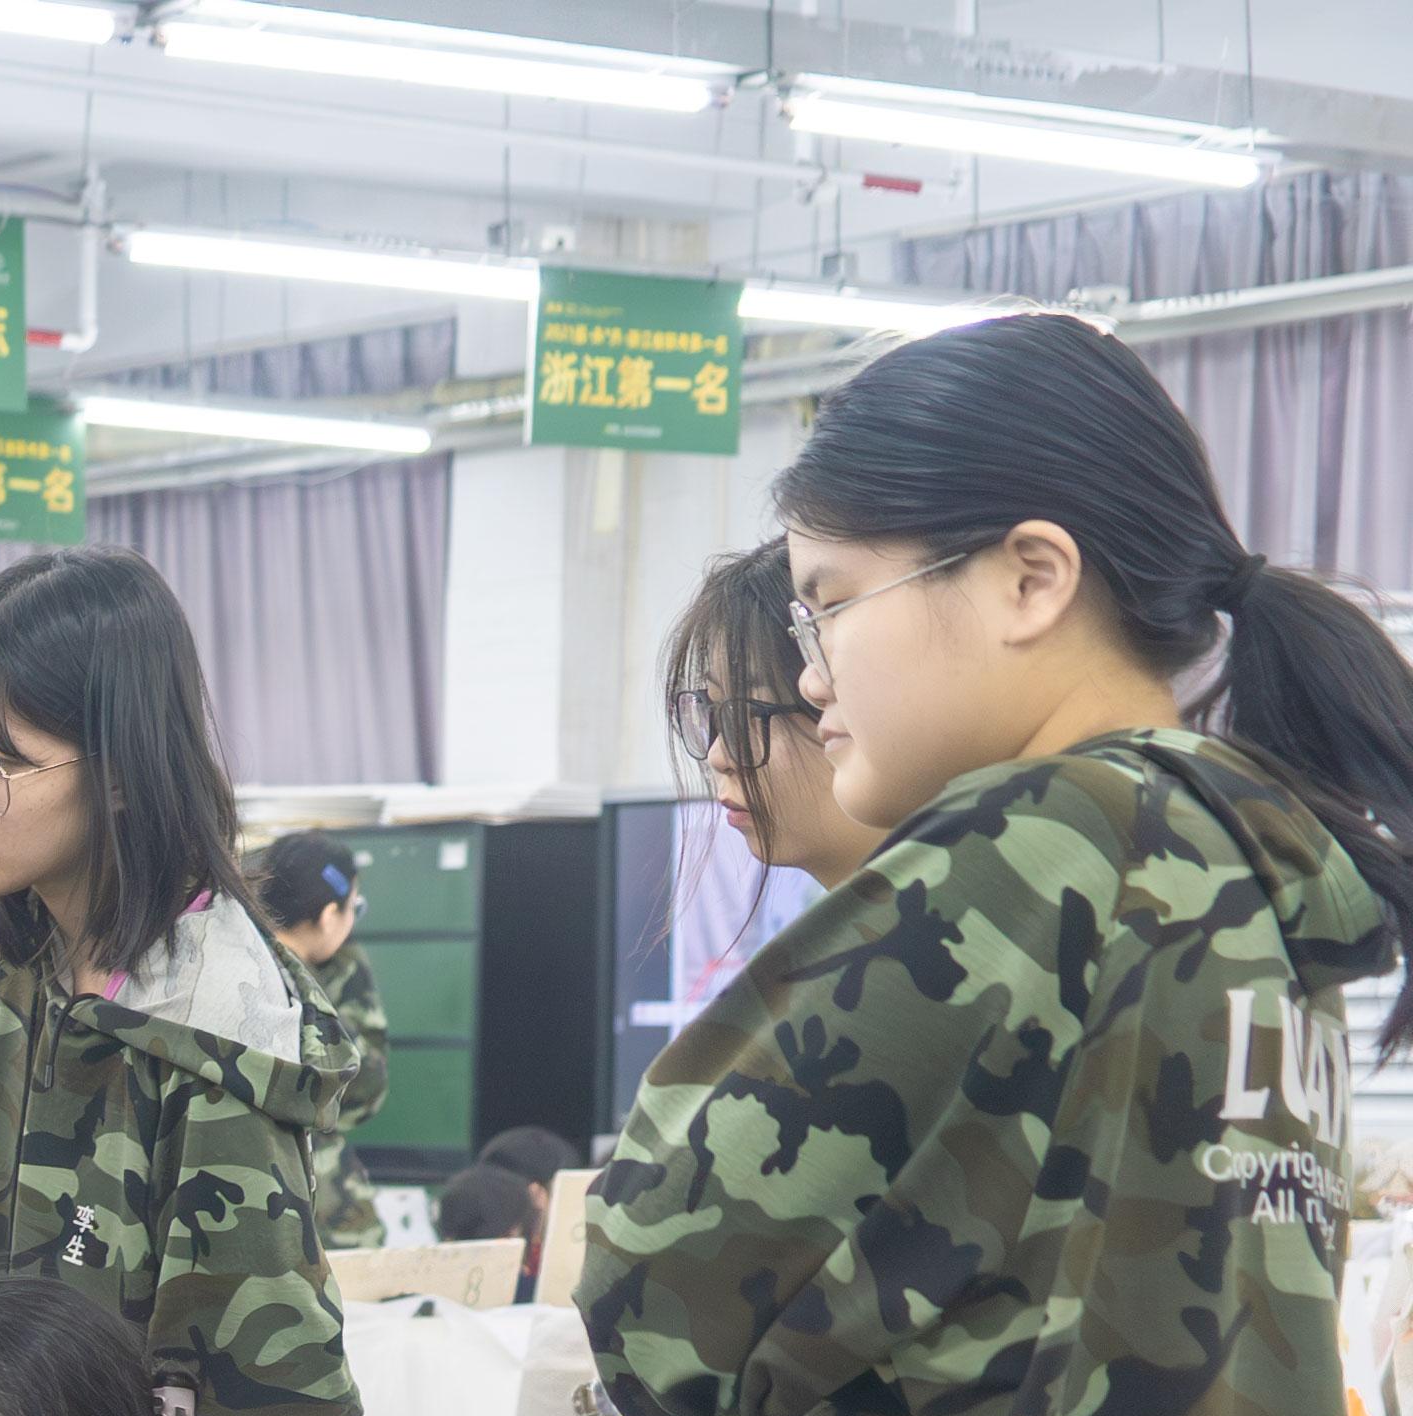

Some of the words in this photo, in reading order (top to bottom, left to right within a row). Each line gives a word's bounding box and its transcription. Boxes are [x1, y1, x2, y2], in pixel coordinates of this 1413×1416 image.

[539, 350, 729, 415] 浙江第一名
[62, 1205, 95, 1266] 孪生
